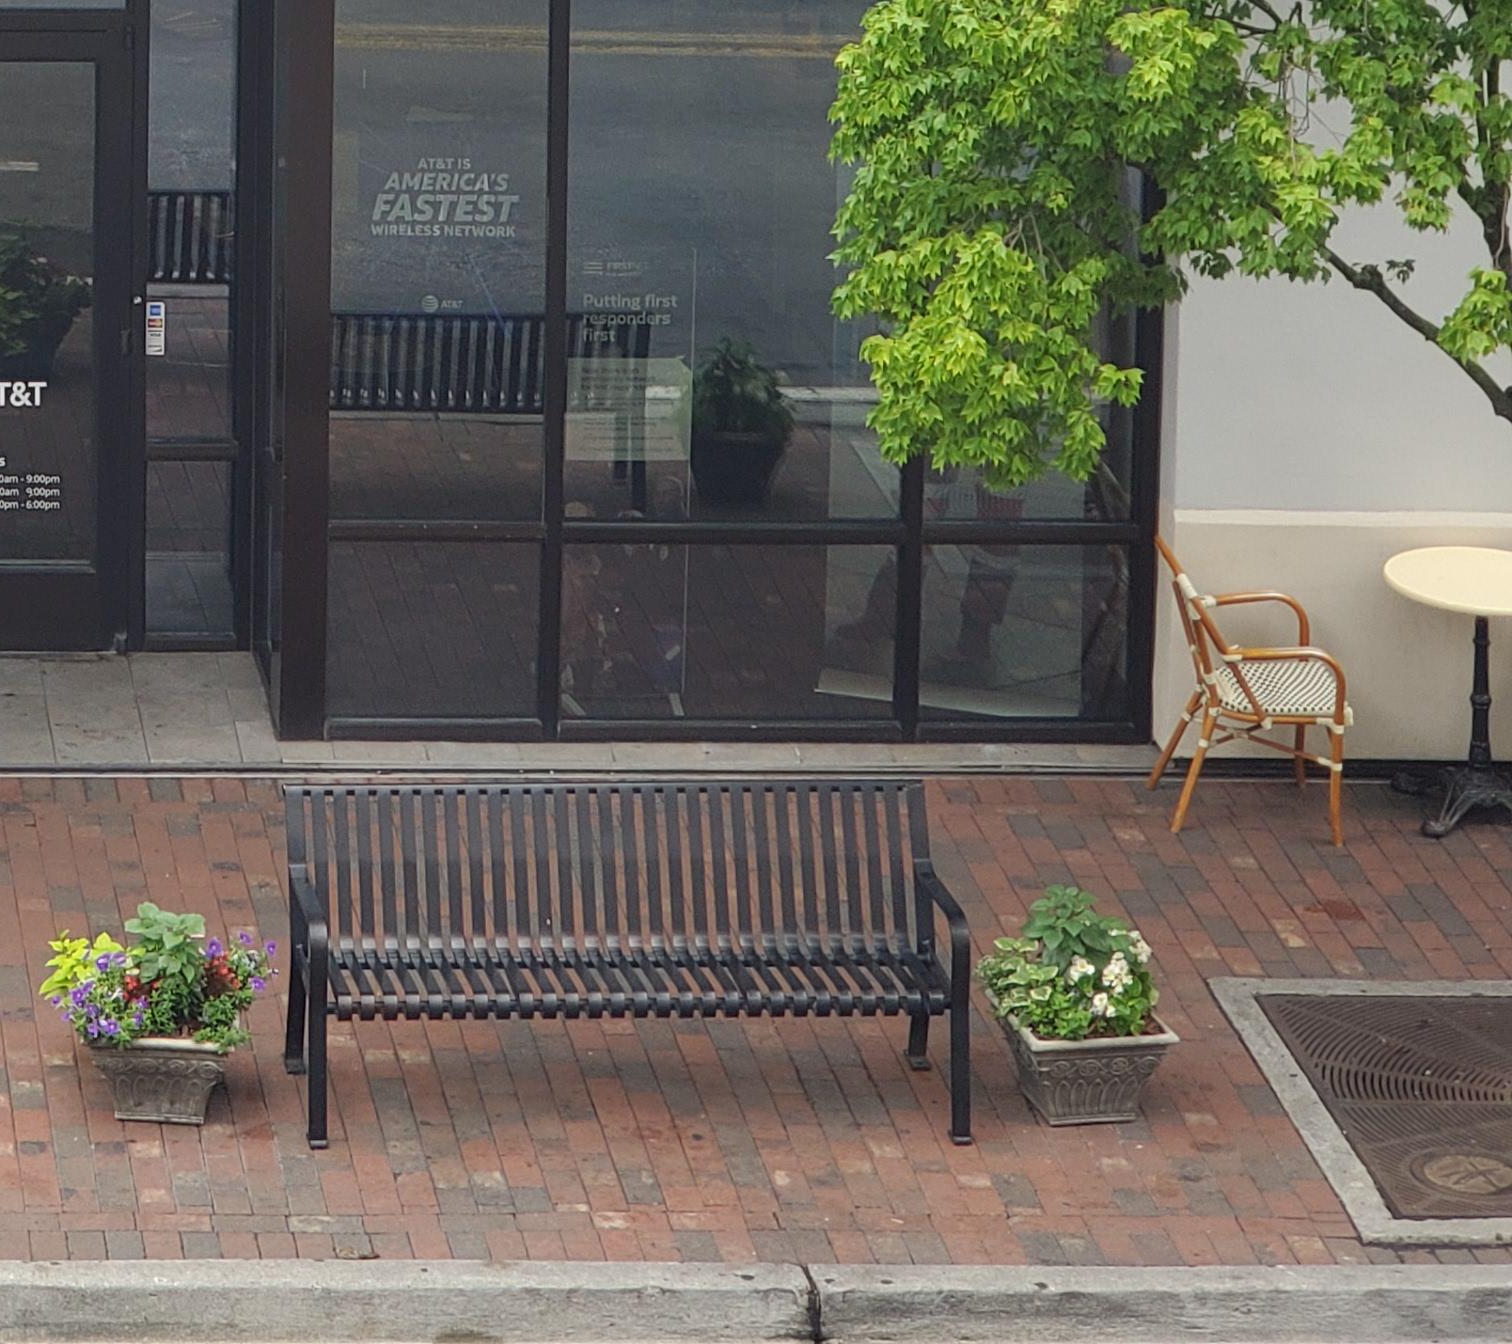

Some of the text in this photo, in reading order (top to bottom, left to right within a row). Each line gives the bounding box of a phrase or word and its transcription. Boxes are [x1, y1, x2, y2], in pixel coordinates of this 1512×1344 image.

[417, 157, 472, 170] AT&T IS
[384, 171, 511, 191] AMERICA'S
[371, 193, 521, 223] FASTEST
[370, 224, 516, 238] WIRELESS NETWORK
[440, 299, 464, 310] AT&T
[583, 293, 679, 310] Putting first
[583, 311, 672, 329] responders
[583, 328, 616, 343] first
[26, 474, 61, 485] 9:00pm
